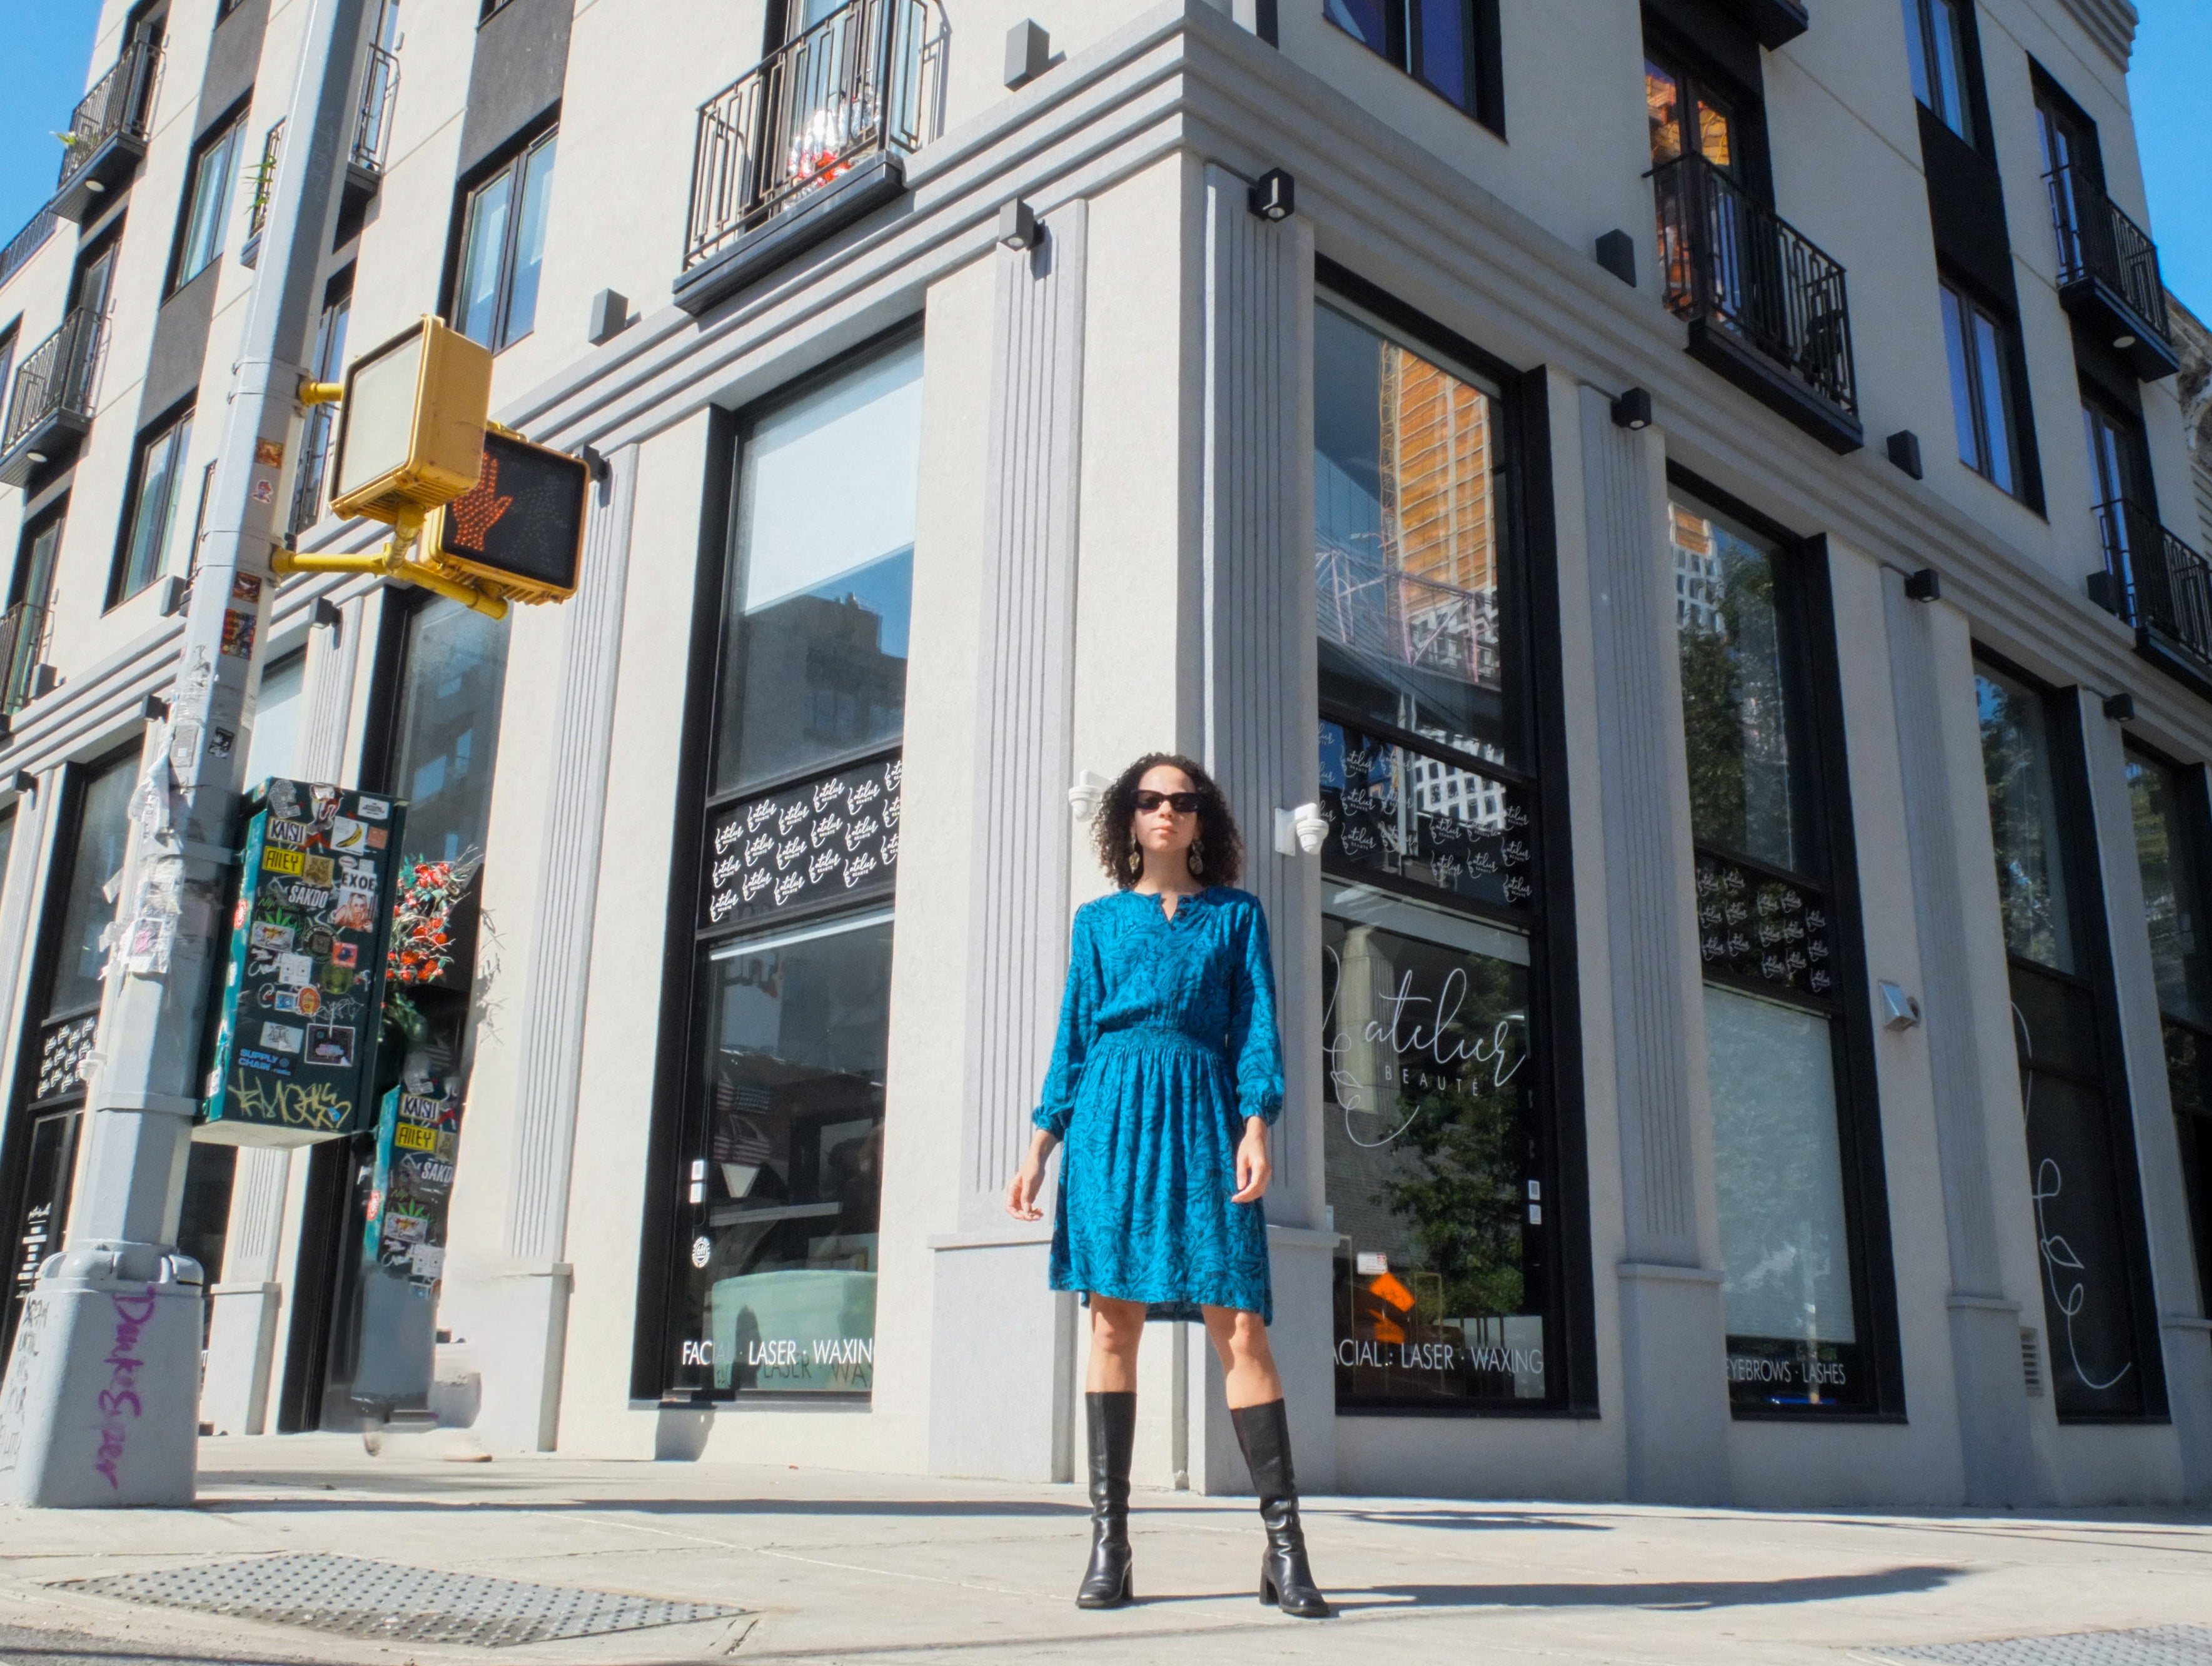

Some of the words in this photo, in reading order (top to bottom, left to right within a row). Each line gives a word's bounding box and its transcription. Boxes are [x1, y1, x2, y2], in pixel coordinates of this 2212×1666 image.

[1365, 968, 1525, 1087] atelier
[748, 1340, 797, 1366] LASER
[813, 1338, 874, 1365] WAXIN
[1401, 1343, 1455, 1370] LASER
[1471, 1346, 1544, 1375] WAXING
[1801, 1361, 1846, 1385] LASHES
